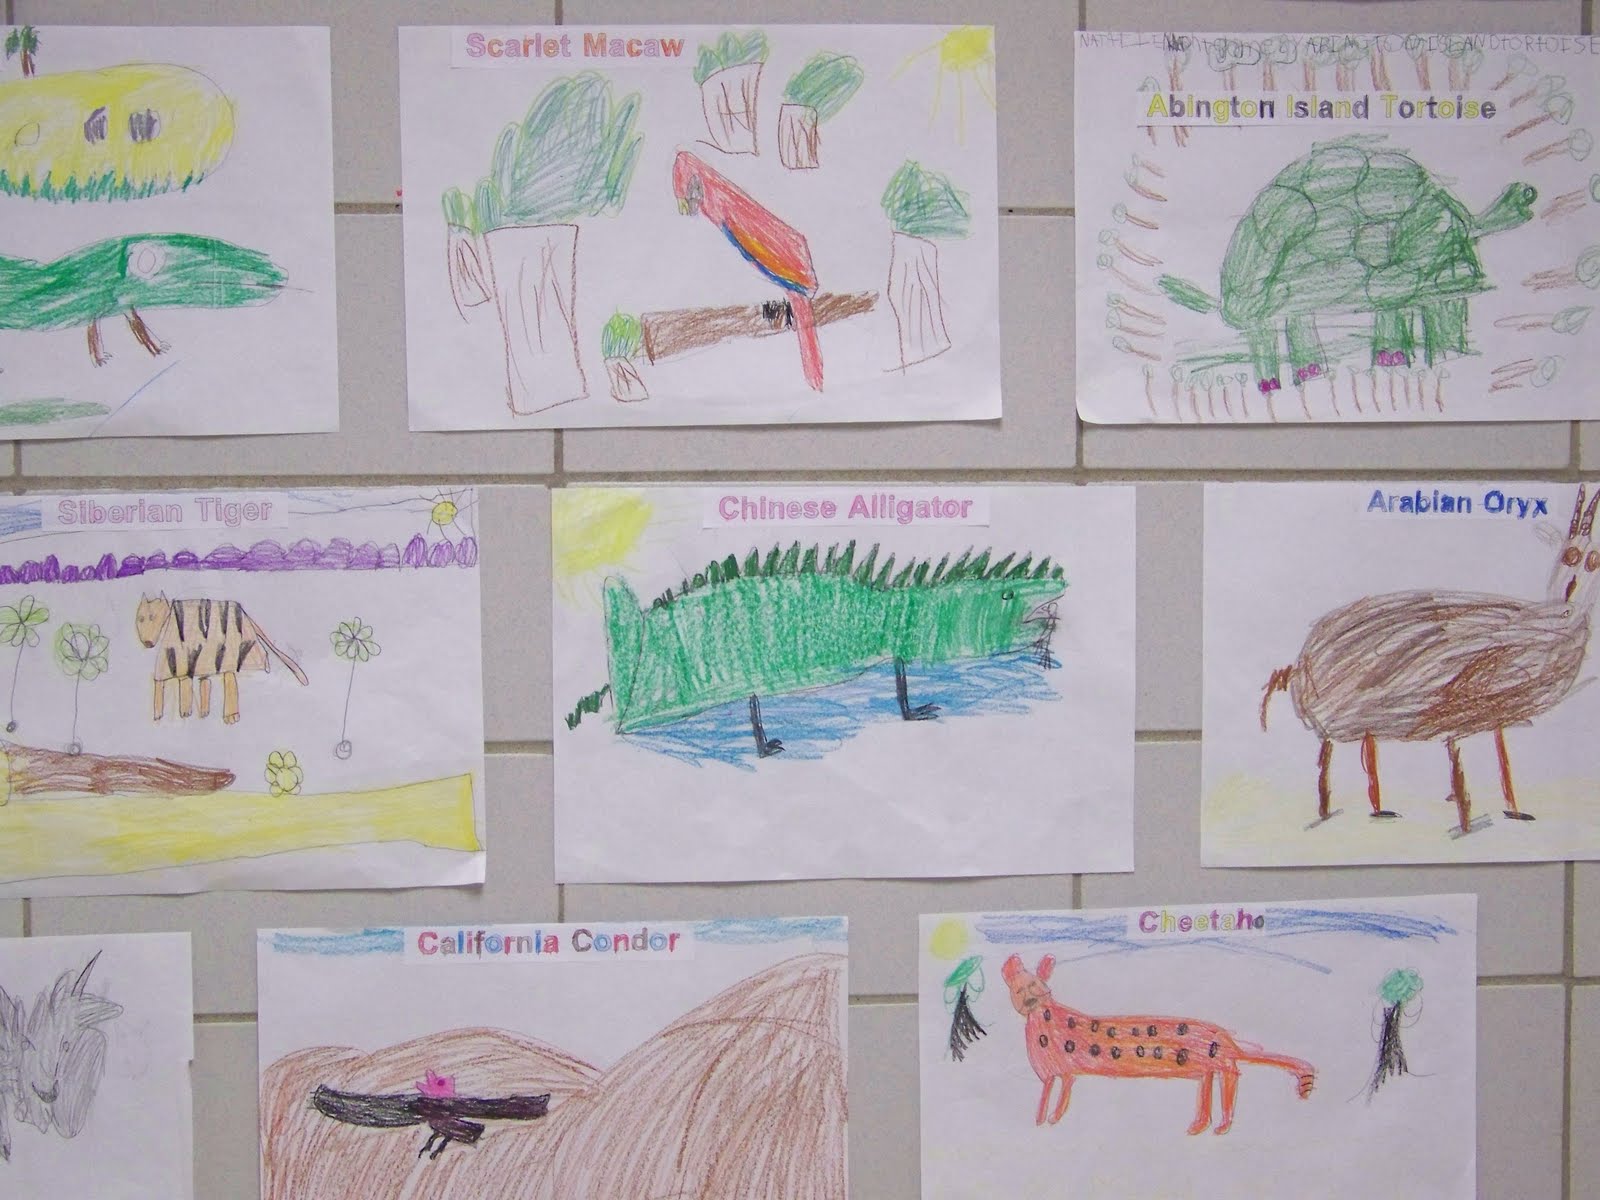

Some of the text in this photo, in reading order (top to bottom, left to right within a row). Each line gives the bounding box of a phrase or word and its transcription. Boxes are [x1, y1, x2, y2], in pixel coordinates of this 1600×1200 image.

[466, 32, 685, 58] Scarlet Macaw
[1147, 94, 1497, 124] Abington Island Tortoise
[57, 498, 272, 527] Siberian Tiger
[718, 494, 973, 525] Chinese Alligator
[1367, 489, 1548, 520] Arabian Oryx
[417, 928, 681, 956] California Condor
